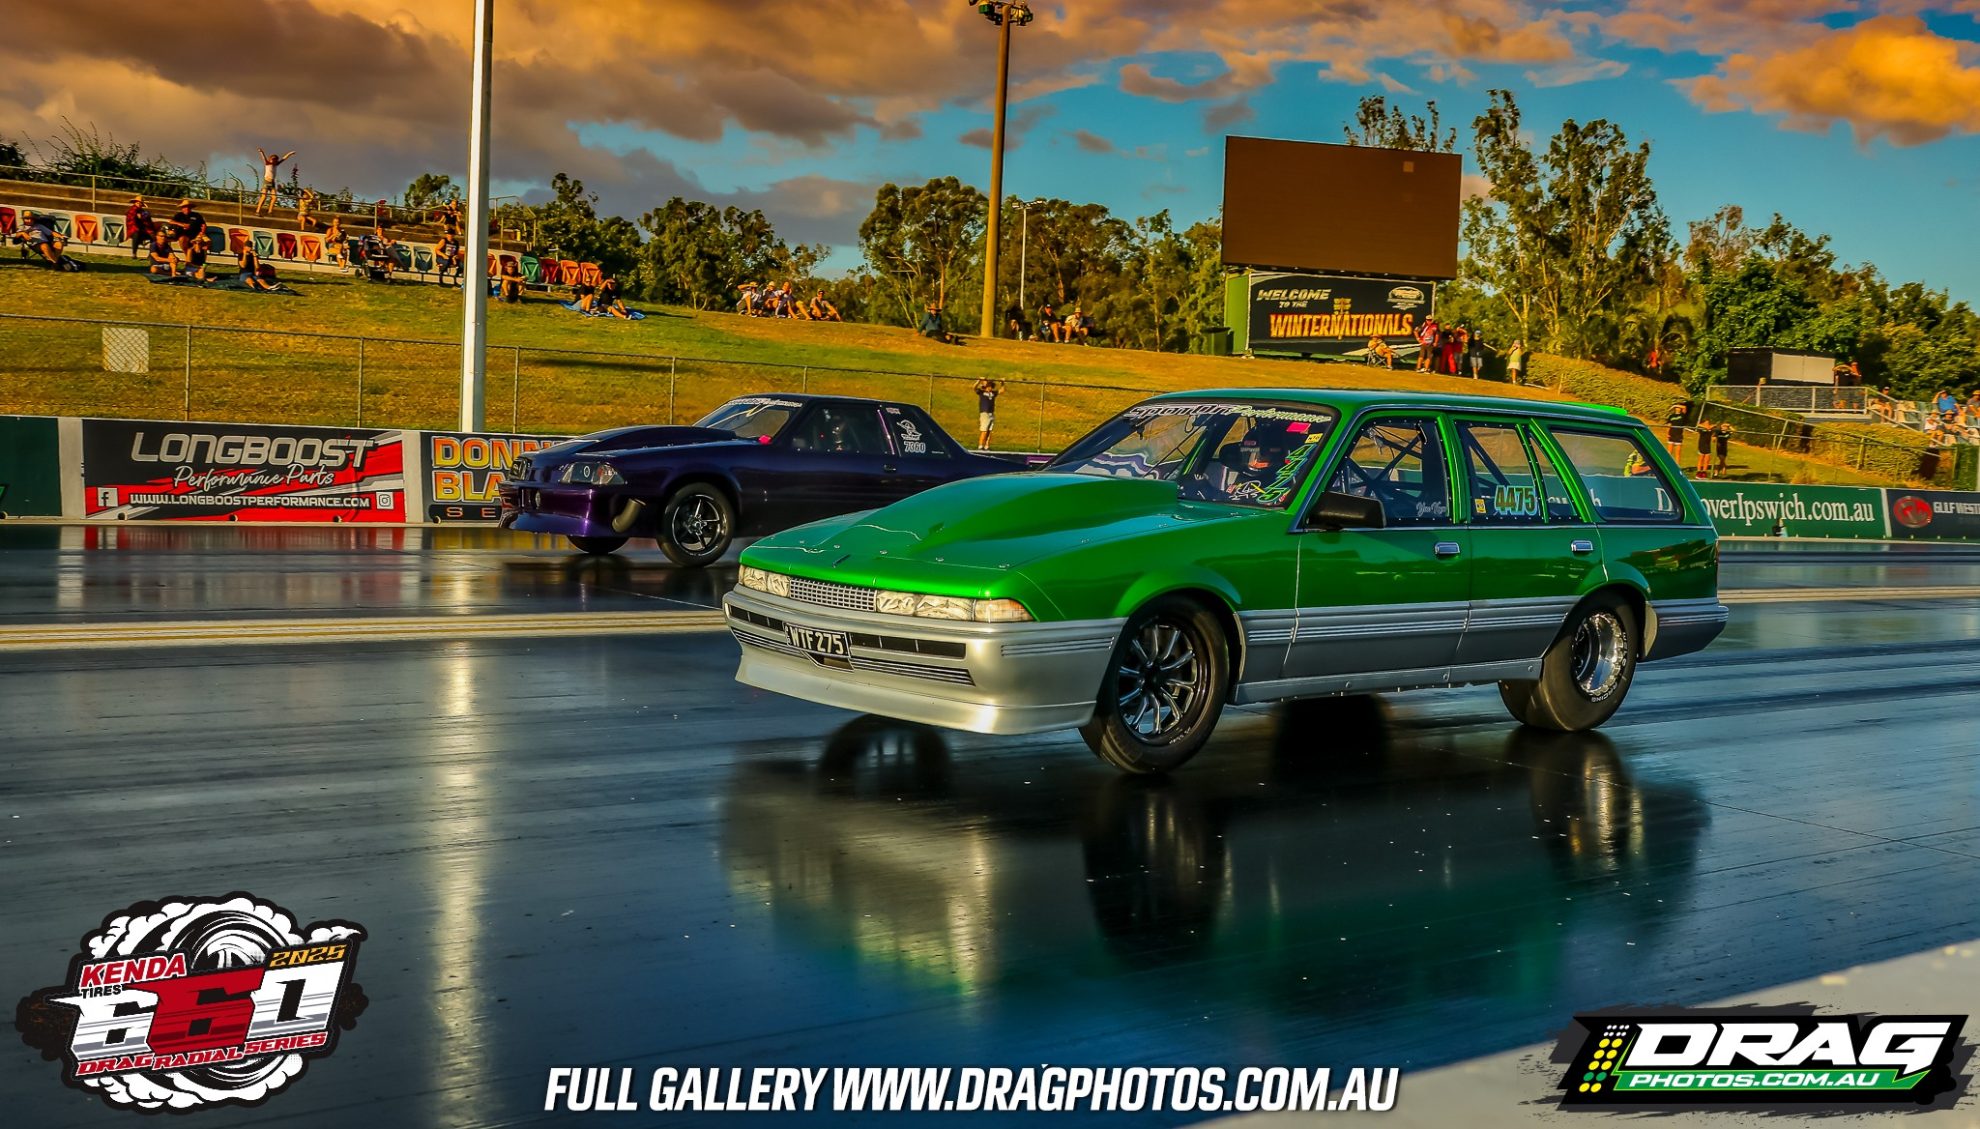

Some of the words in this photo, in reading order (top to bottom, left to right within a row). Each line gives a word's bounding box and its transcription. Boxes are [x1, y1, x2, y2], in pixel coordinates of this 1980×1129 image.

[1256, 289, 1332, 301] WELCOME
[1279, 301, 1290, 309] TO
[1270, 313, 1414, 337] WINTERNATIONALS
[131, 432, 374, 468] LONGBOOST
[174, 465, 284, 492] Performance
[285, 463, 335, 486] Parts
[129, 494, 370, 508] WWW.LONGBOOSTPERFORMANCE.COM
[1494, 485, 1538, 516] 4475
[789, 626, 814, 650] WTF
[815, 632, 844, 655] 275
